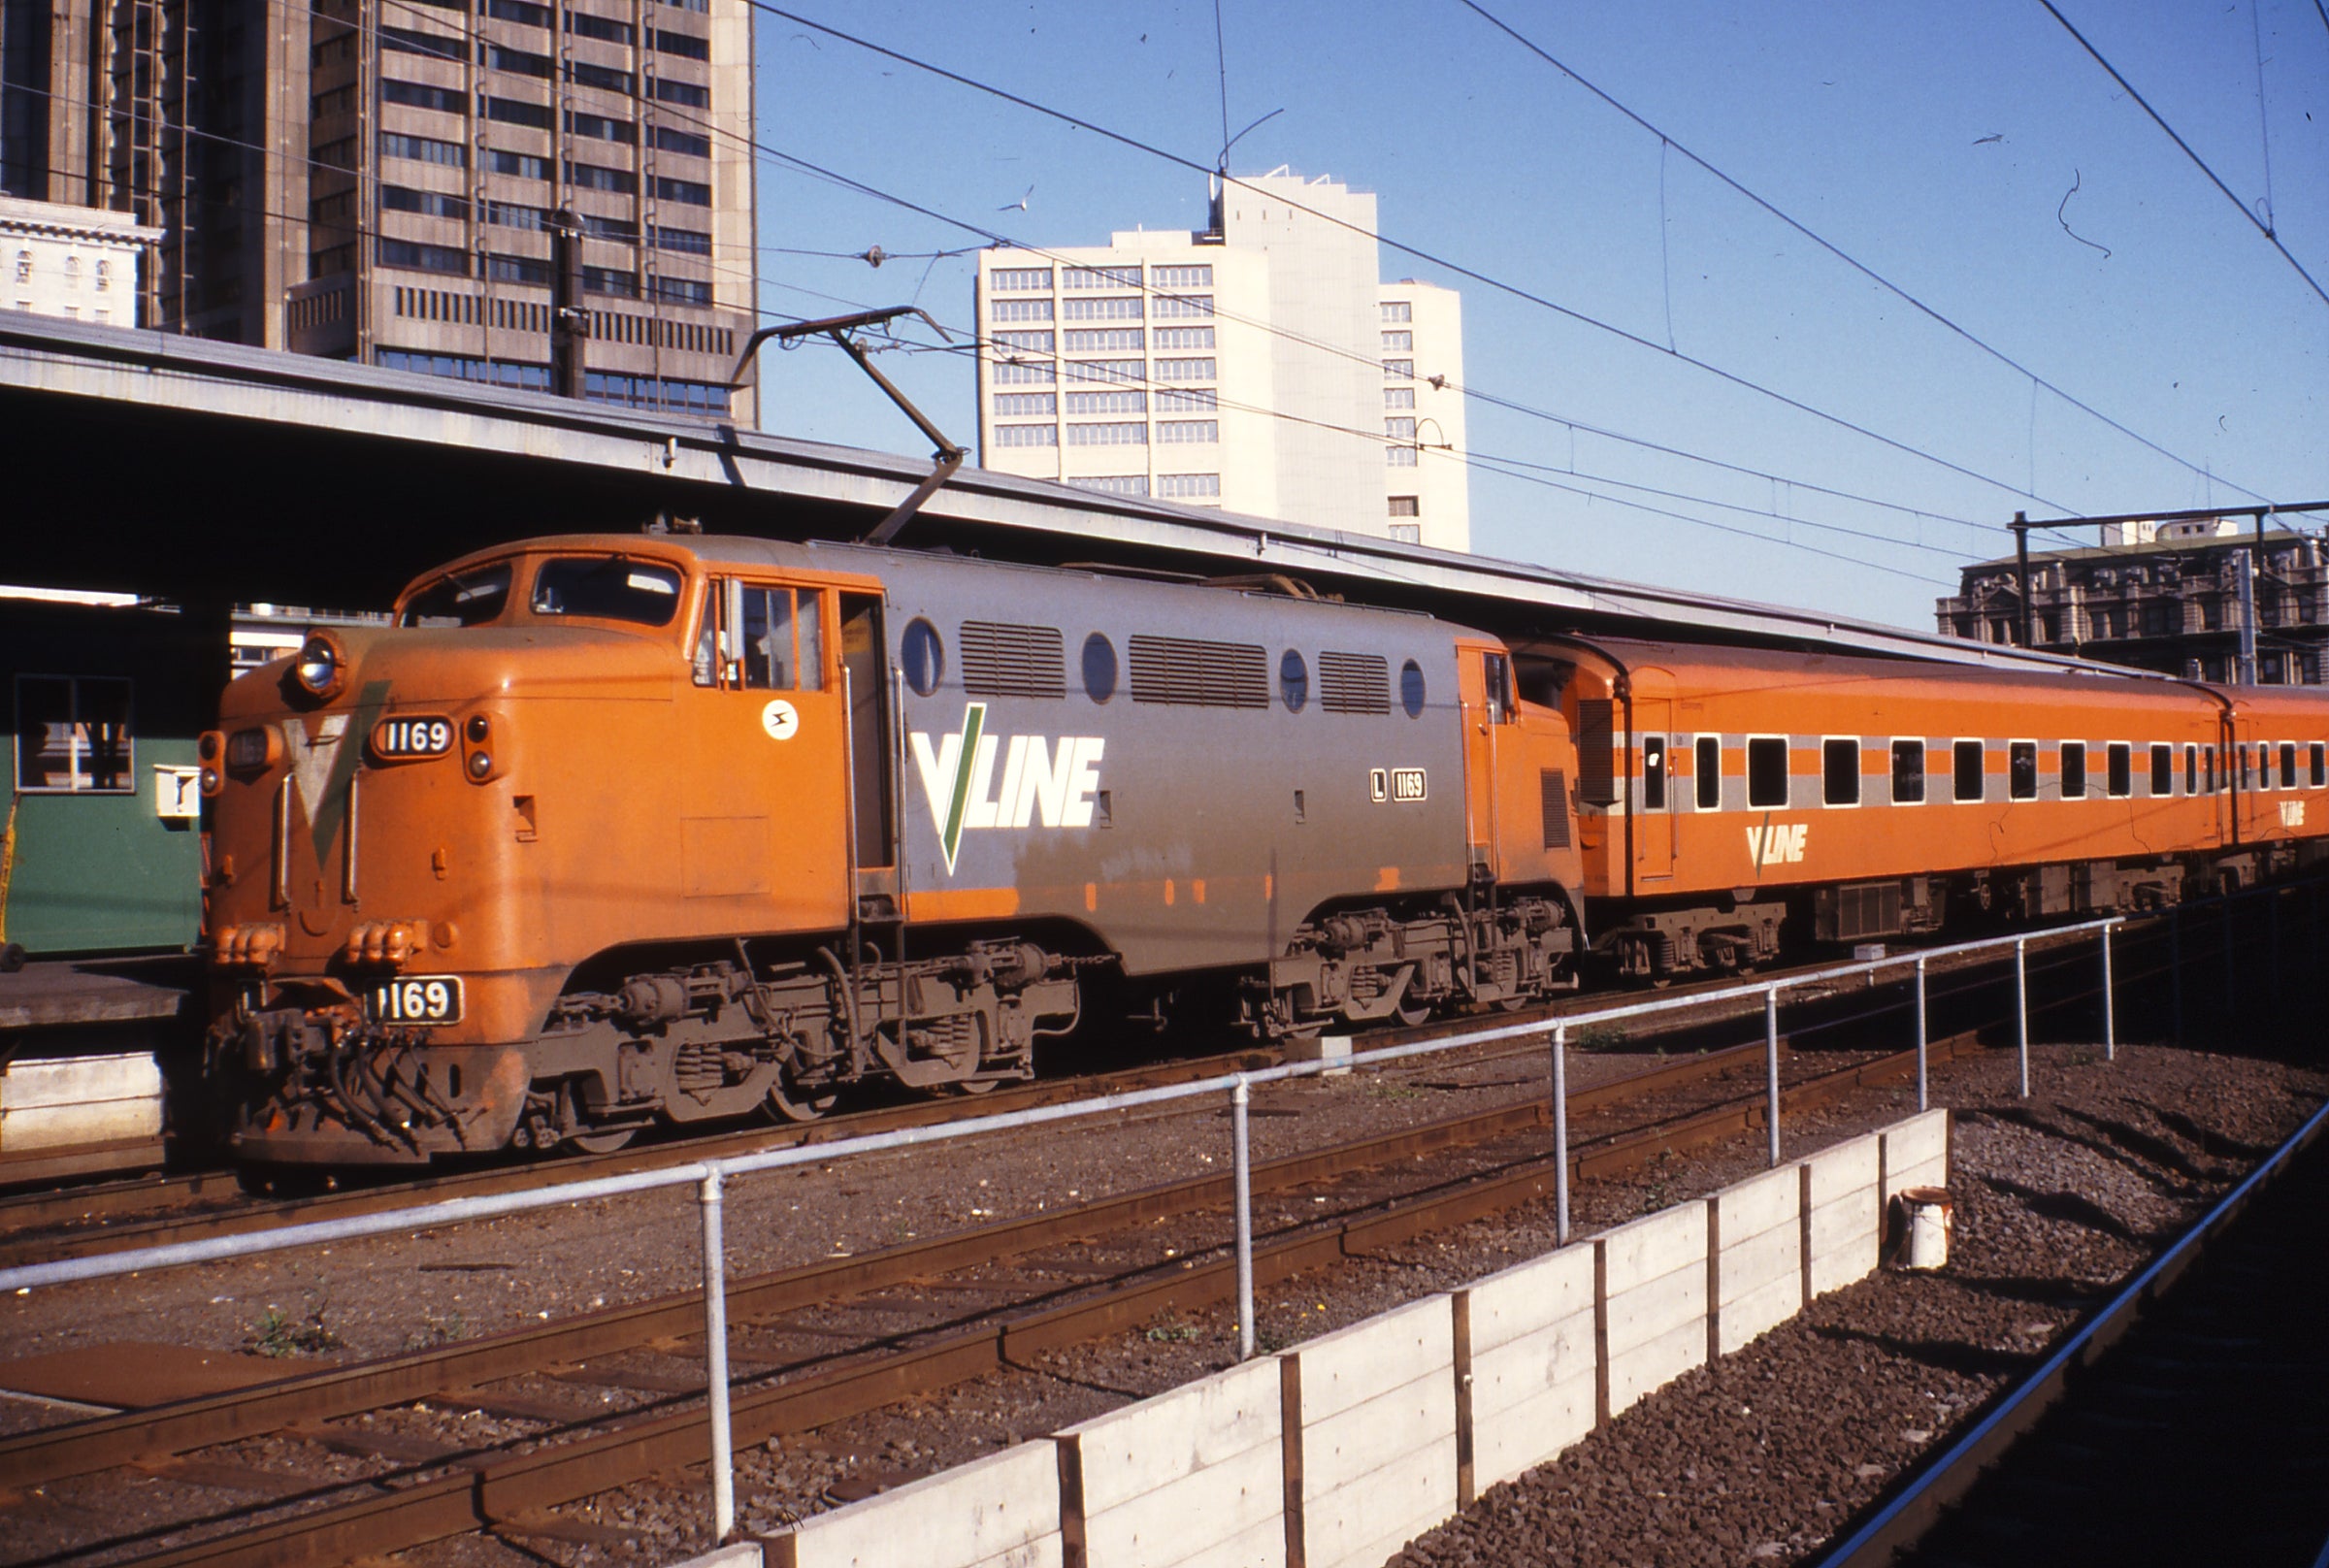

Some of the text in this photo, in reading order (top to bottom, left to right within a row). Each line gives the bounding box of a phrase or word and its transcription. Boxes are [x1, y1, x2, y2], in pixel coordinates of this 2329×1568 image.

[388, 722, 447, 751] 1169
[1373, 772, 1423, 798] L 1169
[377, 982, 449, 1019] 1169
